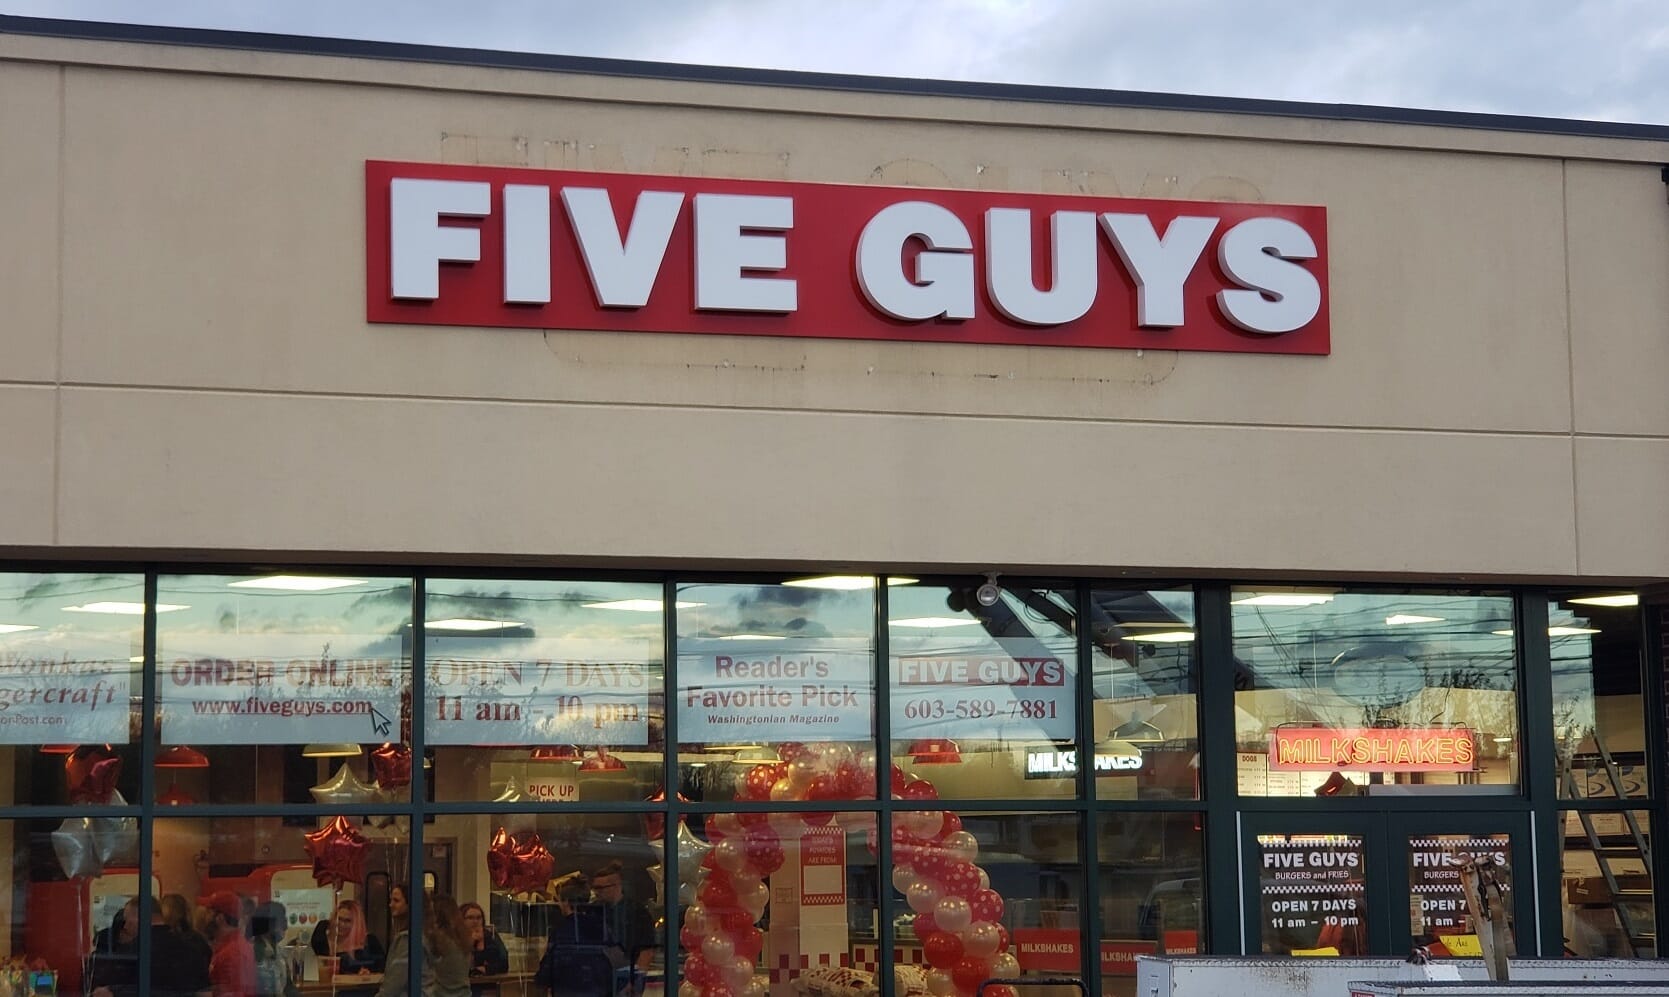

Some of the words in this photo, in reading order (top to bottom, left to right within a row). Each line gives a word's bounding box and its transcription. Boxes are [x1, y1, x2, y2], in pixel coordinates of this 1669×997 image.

[390, 177, 799, 313] FIVE
[855, 200, 1322, 335] GUYS
[171, 657, 275, 687] ORDER
[286, 658, 393, 688] ONLINE
[431, 659, 524, 687] OPEN
[535, 661, 551, 688] 7
[565, 662, 645, 688] DAYS
[715, 655, 829, 679] Reader's
[901, 660, 970, 683] FIVE
[978, 659, 1062, 684] GUYS
[686, 684, 793, 708] Favorite
[801, 684, 859, 708] Pick
[191, 697, 373, 717] www.fiveguys.com
[435, 695, 464, 721] 11
[475, 702, 522, 721] am
[556, 695, 583, 722] 10
[593, 702, 641, 728] pm
[904, 699, 1057, 720] 603-589-7881
[707, 714, 786, 725] Washingtonian
[789, 714, 840, 725] Magazine
[1279, 736, 1474, 765] MILKSHAKES
[1028, 750, 1142, 774] MILKSAKES
[529, 784, 556, 798] PICK
[559, 784, 574, 797] UP
[1263, 852, 1304, 868] FIVE
[1309, 851, 1359, 867] GUYS
[1412, 852, 1452, 867] FIVE
[1275, 871, 1312, 880] BURGERS
[1313, 871, 1327, 879] and
[1328, 870, 1349, 879] FRIES
[1424, 870, 1459, 879] BURGERS
[1271, 900, 1308, 912] OPEN
[1311, 900, 1319, 911] 7
[1322, 899, 1357, 911] DAYS
[1420, 899, 1456, 911] OPEN
[1459, 900, 1466, 910] 7
[1272, 917, 1283, 928] 11
[1287, 918, 1306, 928] am
[1324, 915, 1338, 926] 10
[1340, 916, 1359, 927] pm
[1421, 916, 1431, 927] 11
[1435, 918, 1453, 926] am
[1021, 943, 1074, 954] MILKSHAKES
